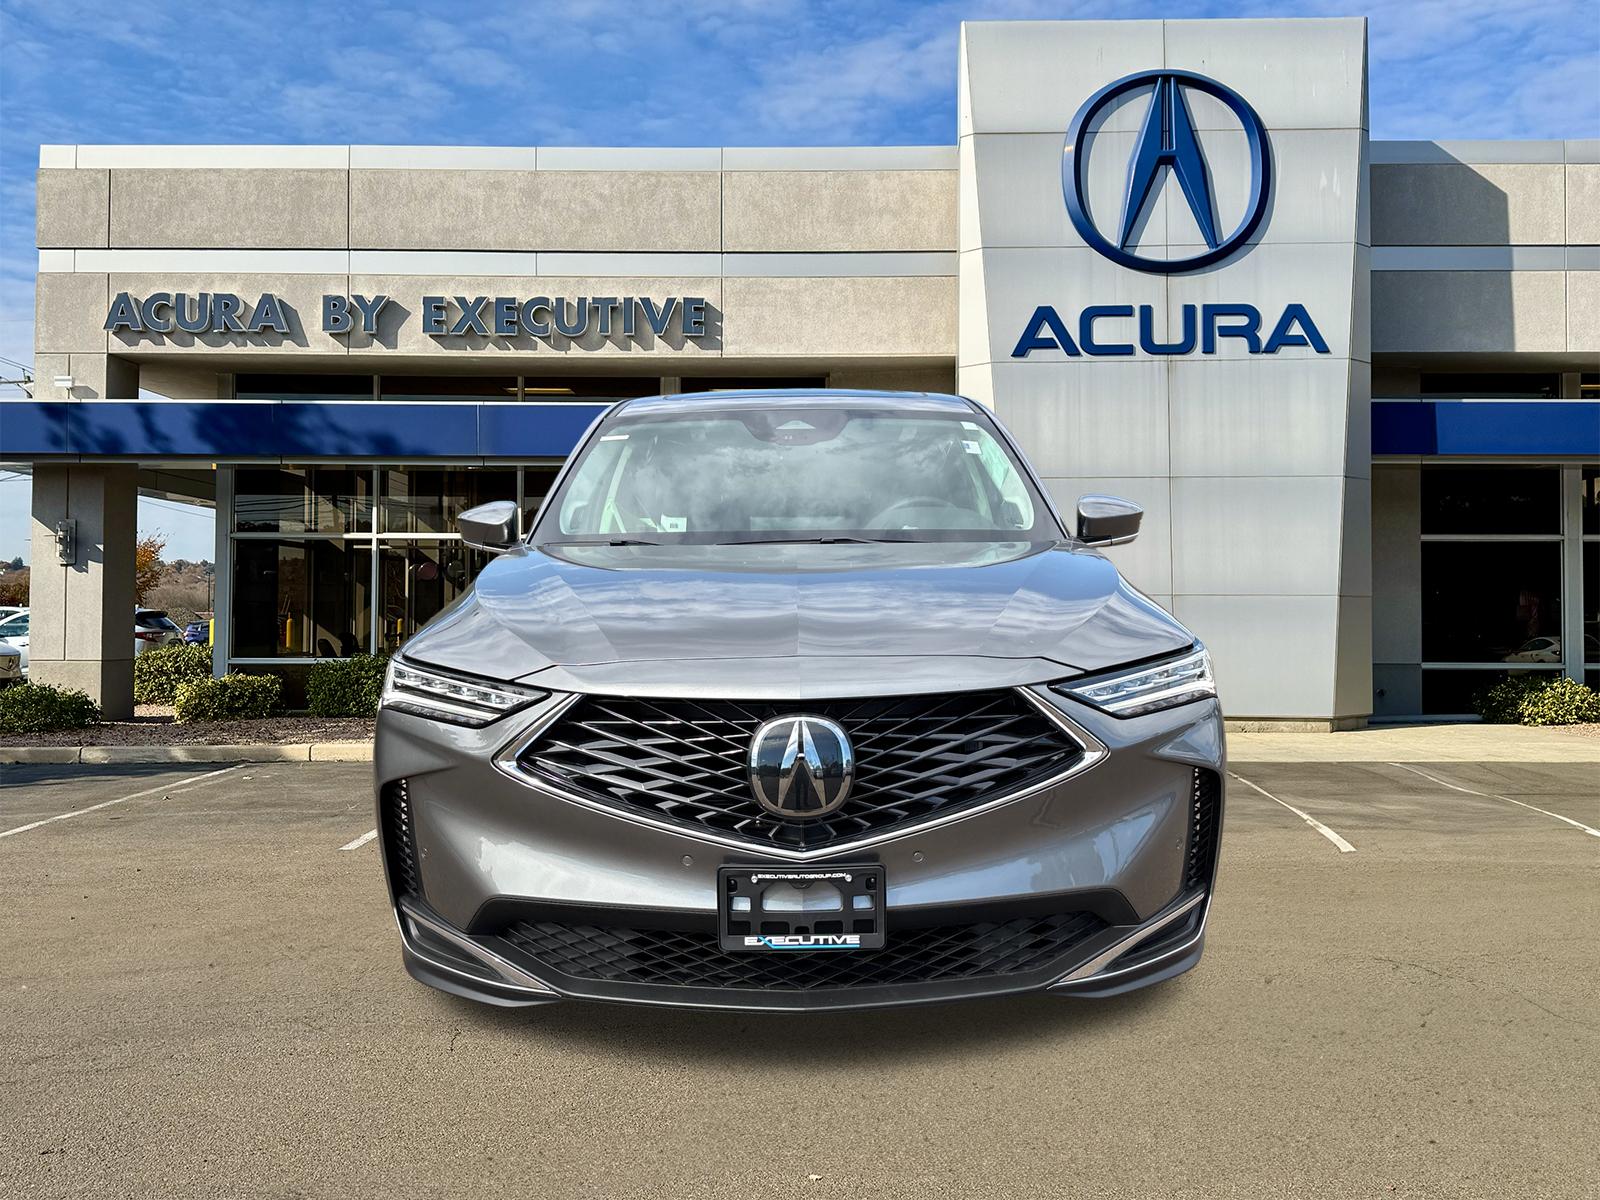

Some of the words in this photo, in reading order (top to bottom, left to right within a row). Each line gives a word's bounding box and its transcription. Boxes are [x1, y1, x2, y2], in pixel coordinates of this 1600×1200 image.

[103, 291, 290, 334] ACURA
[321, 294, 390, 335] BY
[421, 295, 707, 337] EXECUTIVE
[1010, 303, 1333, 358] ACURA
[744, 934, 861, 948] EXECUTIVE
